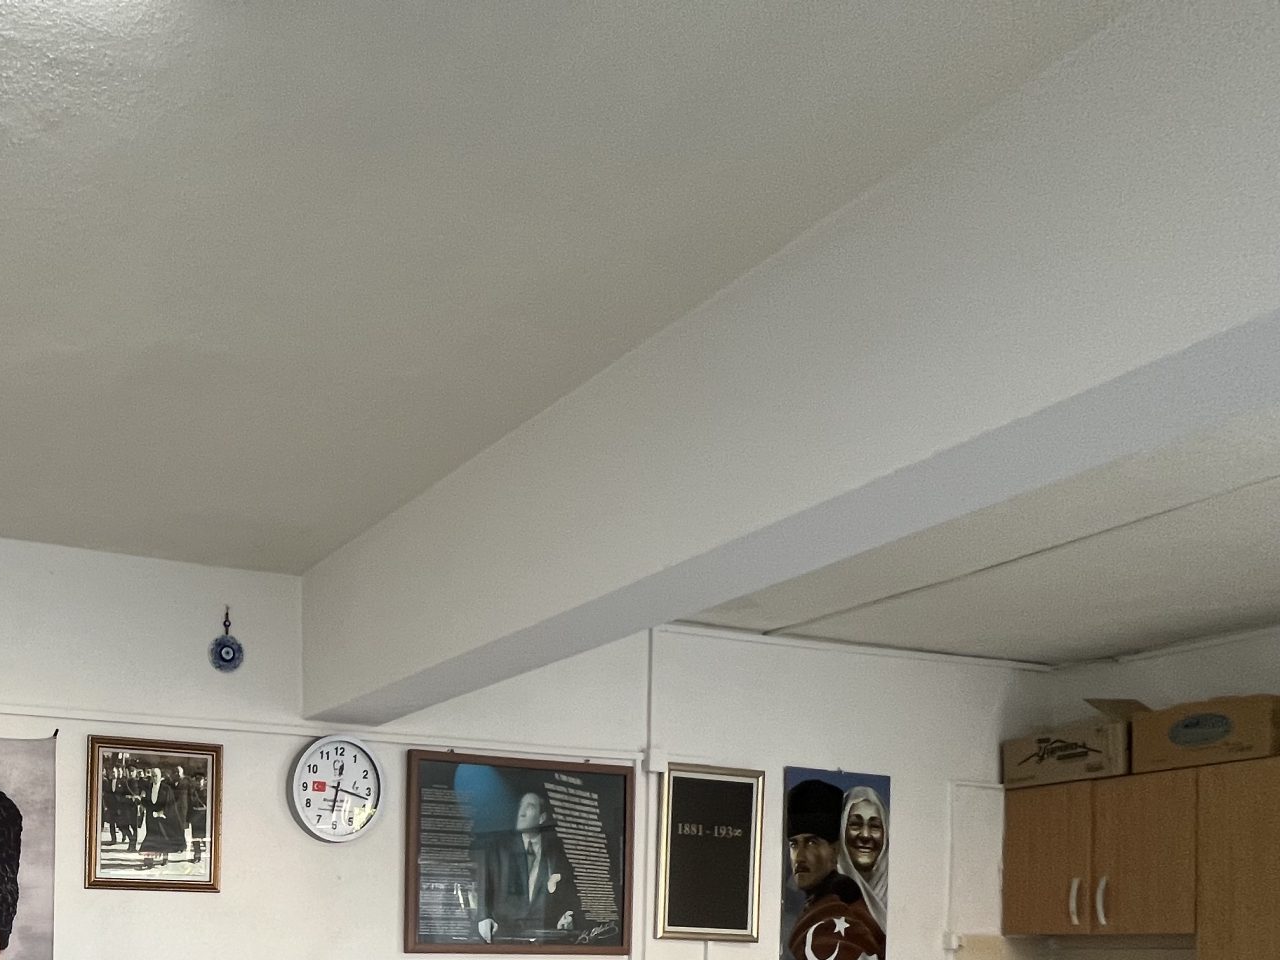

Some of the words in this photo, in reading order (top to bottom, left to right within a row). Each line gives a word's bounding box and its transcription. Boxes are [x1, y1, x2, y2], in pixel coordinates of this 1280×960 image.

[320, 750, 330, 761] 11
[334, 746, 345, 757] 12
[307, 764, 318, 774] 10
[362, 769, 369, 780] 2
[302, 781, 308, 791] 9
[365, 787, 372, 797] 3
[305, 798, 311, 808] 8
[316, 814, 322, 824] 7
[347, 816, 354, 827] 5
